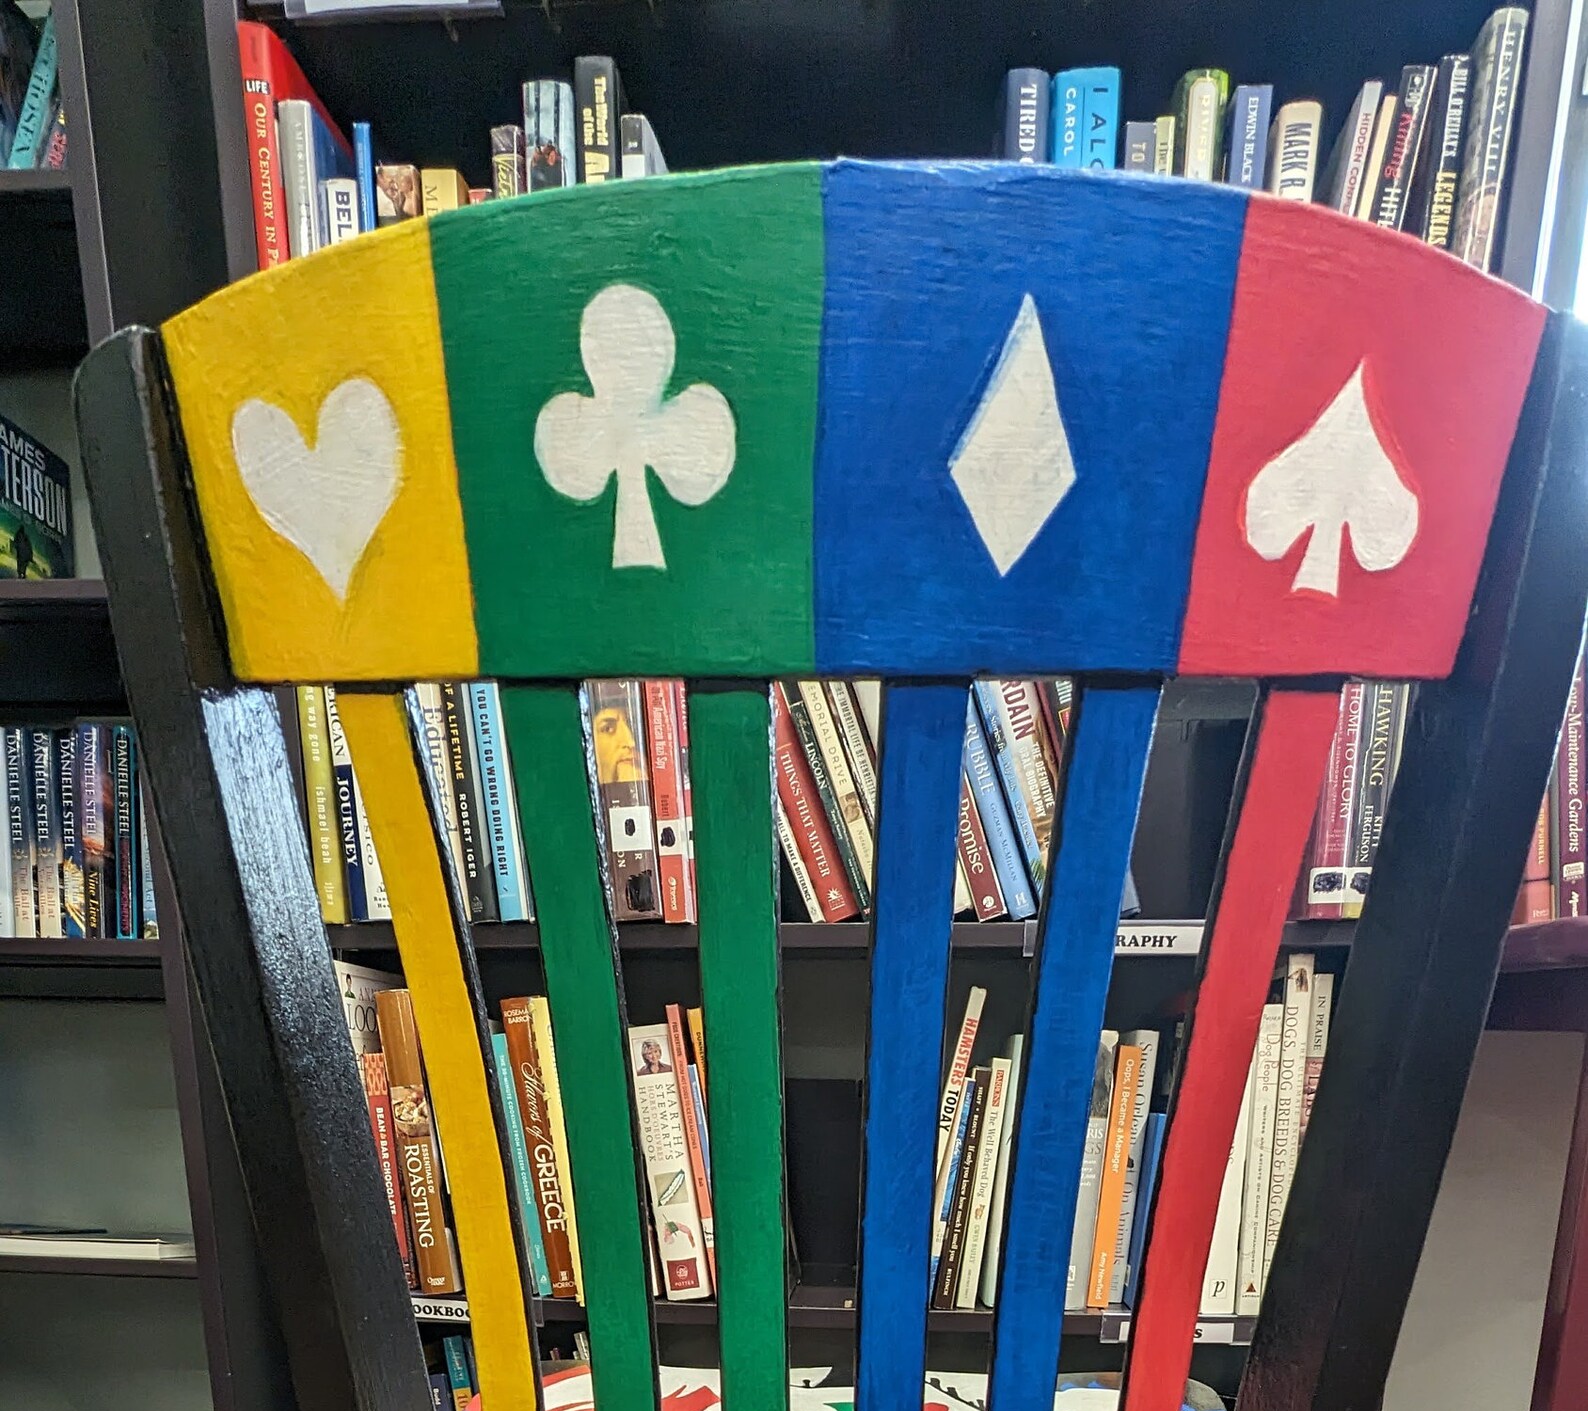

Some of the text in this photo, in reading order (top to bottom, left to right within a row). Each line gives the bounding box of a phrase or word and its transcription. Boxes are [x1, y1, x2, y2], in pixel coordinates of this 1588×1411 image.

[245, 79, 269, 94] LIFE
[594, 76, 606, 102] The
[1451, 66, 1468, 99] BILL
[1487, 30, 1516, 171] HENRY VIII
[583, 107, 595, 145] of the
[595, 103, 609, 145] World
[1020, 84, 1037, 152] TIRED
[1064, 87, 1077, 157] CAROL
[1241, 97, 1259, 183] EDWIN BLACK
[1281, 122, 1313, 173] MARK
[1354, 112, 1371, 163] HIDDEN
[254, 102, 277, 243] OUR CENTURY IN
[1132, 142, 1147, 162] TO
[335, 190, 352, 240] BEL
[1428, 171, 1457, 246] LEGENDS
[653, 706, 665, 741] American
[837, 697, 863, 759] IMMORTAL LIFE OF
[989, 715, 1001, 742] Stories
[1340, 687, 1361, 819] HOME TO GLORY
[1369, 688, 1393, 787] HAWKING
[7, 734, 23, 844] DANIELLE STEEL
[33, 732, 49, 842] DANIELLE STEEL
[83, 731, 97, 835] DANIELLE STEEL
[117, 739, 130, 834] DANIELLE STEEL
[307, 708, 333, 864] way gone ishmael beah
[422, 704, 458, 832] Educated
[446, 701, 477, 879] A LIFETIME ROBERT IGER
[476, 688, 509, 876] YOU CAN'T GO WRONG DOING RIGHT
[656, 757, 668, 770] Spy
[805, 742, 828, 790] LINCOLN
[828, 748, 848, 786] DRIVE
[966, 723, 996, 796] RUBBLE
[1019, 746, 1032, 769] ORAL
[1032, 742, 1056, 808] THE DEFINITIVE
[60, 738, 76, 850] DANIELLE STEEL
[336, 776, 358, 866] JOURNEY
[780, 751, 830, 878] THINGS THAT MATTER
[1025, 771, 1047, 818] BIOGRAPHY
[1568, 798, 1583, 853] Gardens
[782, 831, 812, 902] TO MAKE DIFFERENCE
[1359, 805, 1375, 863] FERGUSON
[1536, 828, 1545, 865] PURNELL
[21, 888, 30, 908] Ball
[46, 864, 54, 881] The
[47, 886, 56, 907] Ball
[88, 871, 99, 928] Nine Lives
[1313, 995, 1327, 1051] IN PRAISE
[939, 1017, 978, 1132] HAMSTERS TODAY
[1137, 1041, 1152, 1088] Susan
[1259, 1033, 1280, 1093] Dog People
[639, 1086, 657, 1162] HANDBOOK
[648, 1085, 657, 1109] HORS
[655, 1083, 674, 1161] STEWART'S
[664, 1083, 684, 1159] MARTHA
[1267, 1005, 1299, 1247] DOGS, DOG BREEDS & DOG CARE
[375, 1107, 397, 1215] BEAN BAR CHOCOLATE
[421, 1144, 435, 1194] ESSENTIALS OF
[507, 1101, 532, 1205] COOKING FROM FROZEN COOKBOOK
[519, 1061, 566, 1233] Flavors of GREECE
[976, 1111, 998, 1199] The Well Behaved Dog
[1095, 1058, 1135, 1300] Oops, Became Manager Amy Newfield
[404, 1144, 435, 1249] ROASTING
[948, 1115, 979, 1262] BLOUNT only you knew how much smell you
[553, 1281, 576, 1290] MORRO
[674, 1280, 695, 1288] POTTER
[433, 1388, 441, 1406] Budd
